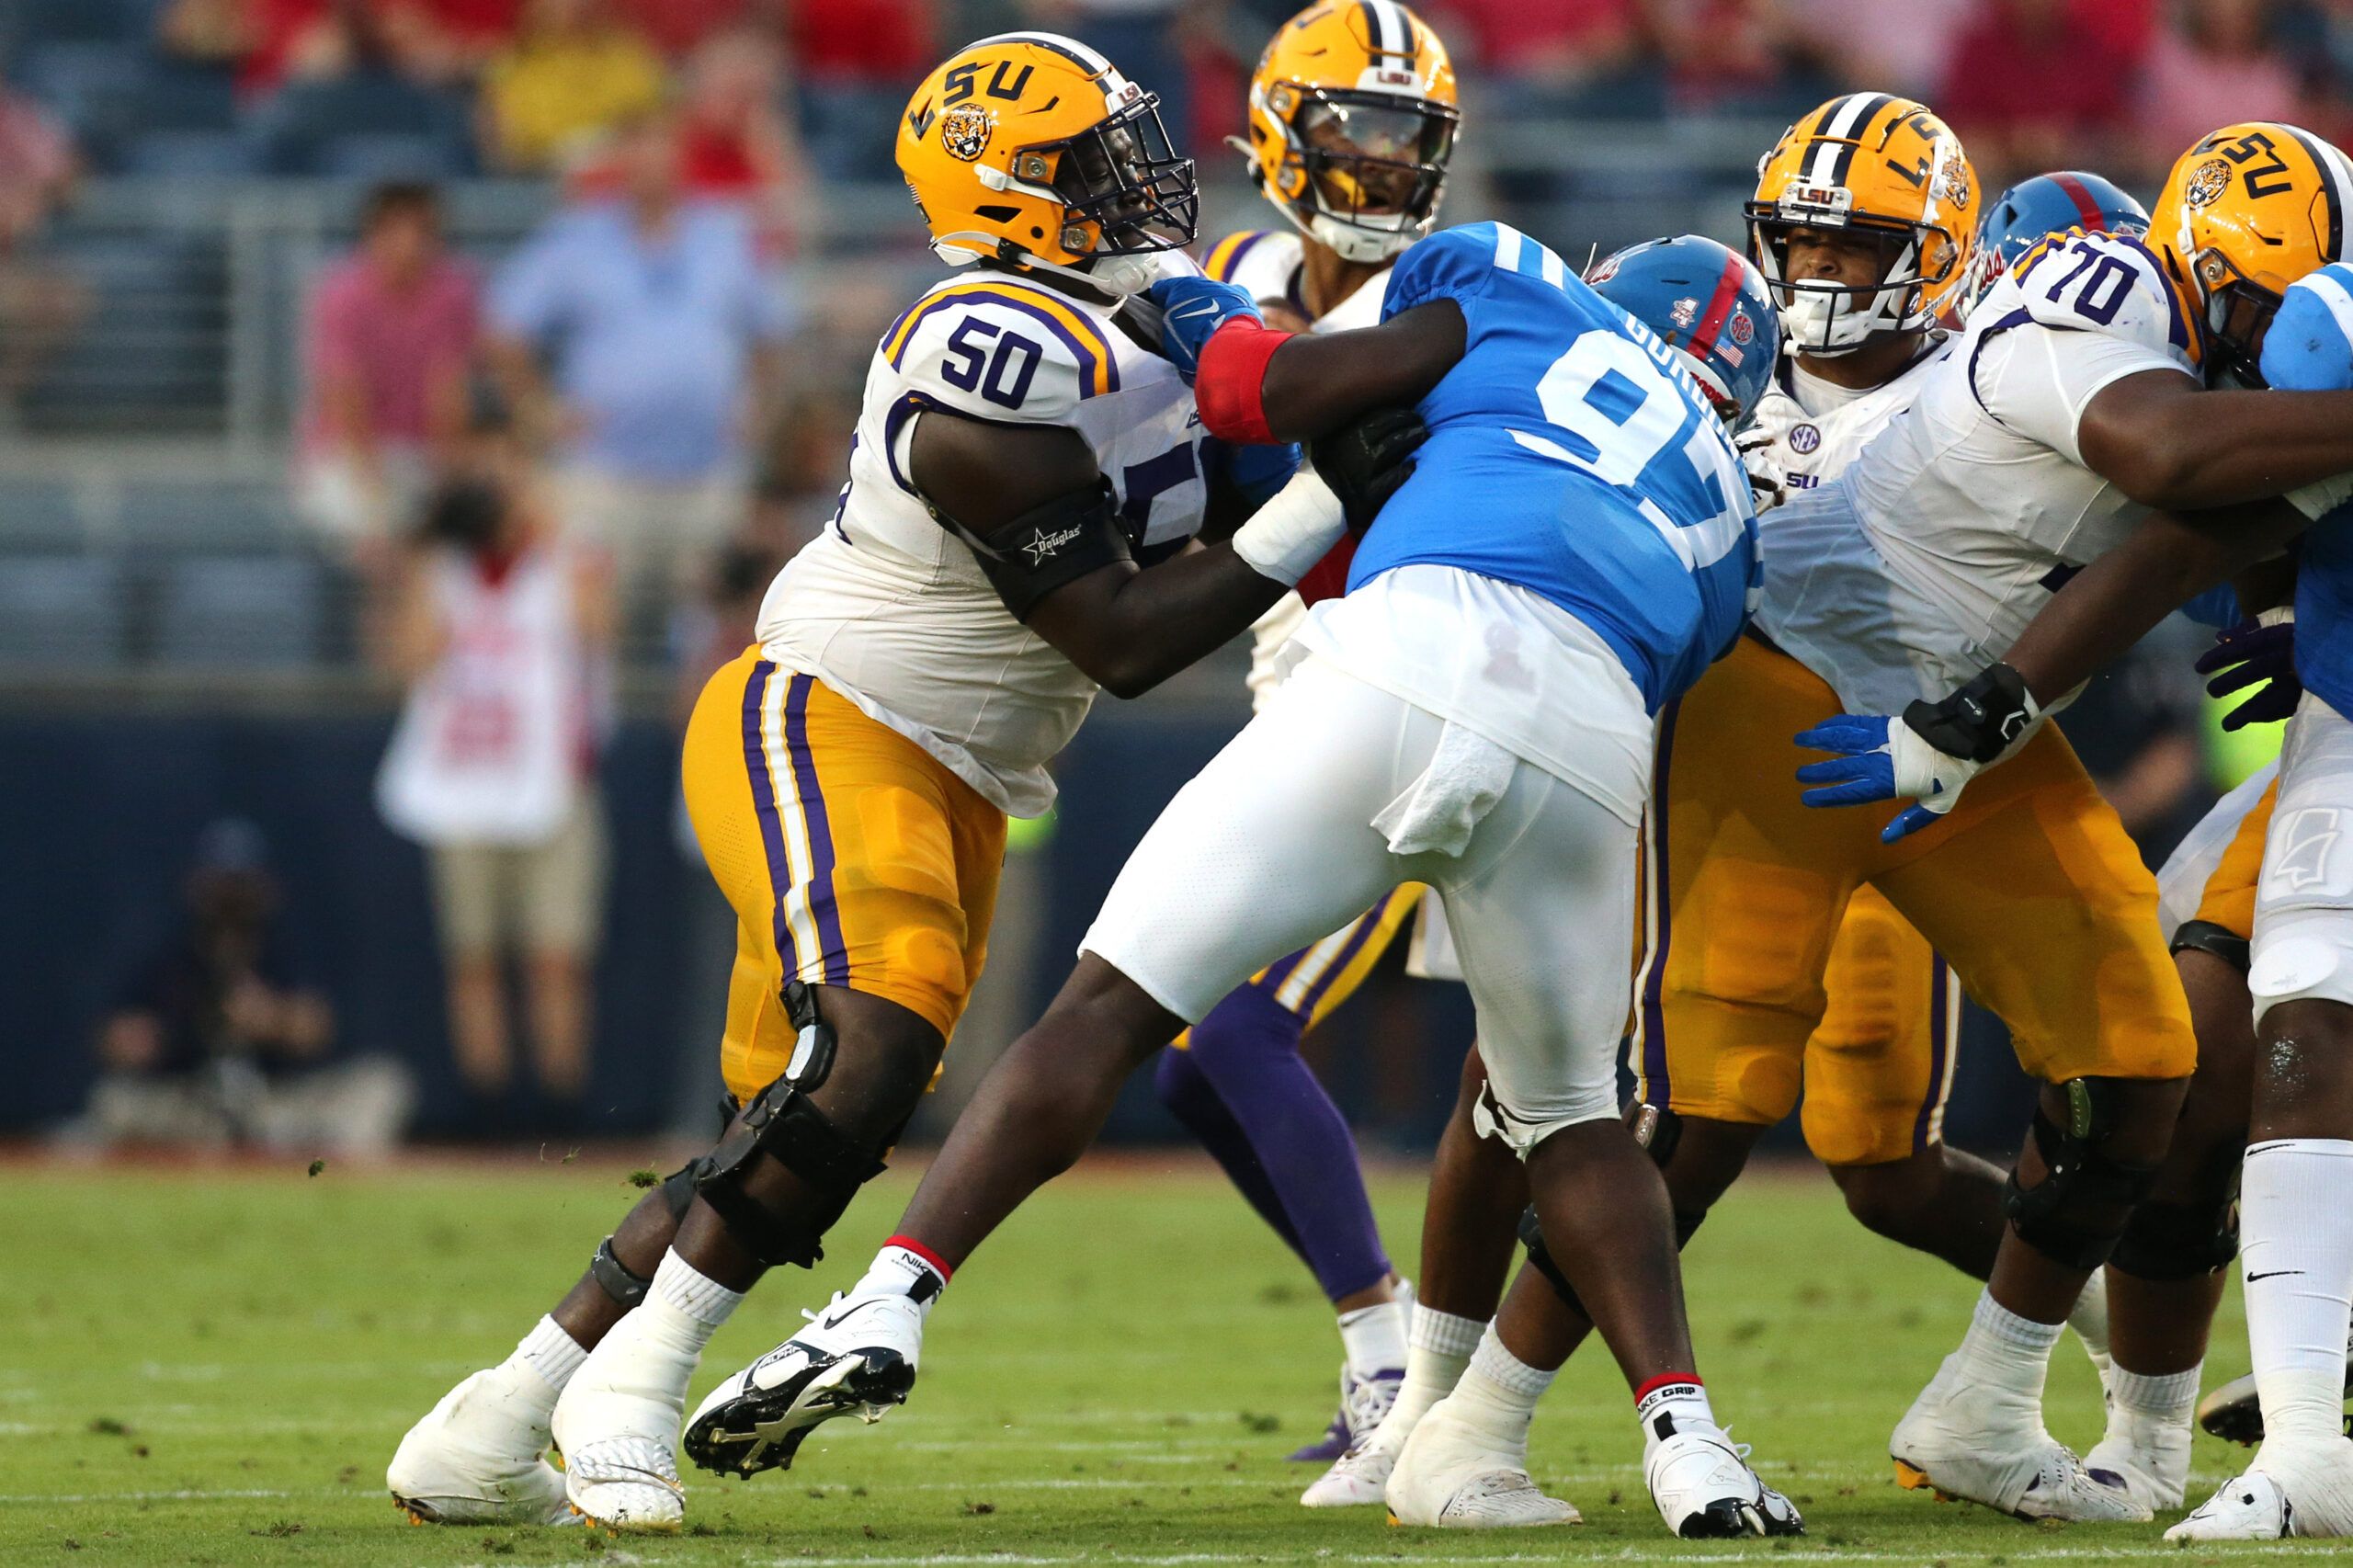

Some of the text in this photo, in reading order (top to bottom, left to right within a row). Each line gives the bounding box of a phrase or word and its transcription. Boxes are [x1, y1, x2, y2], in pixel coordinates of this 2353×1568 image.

[908, 61, 1034, 142] LSU
[1798, 187, 1834, 205] LSU
[2045, 241, 2140, 326] 70
[941, 315, 1042, 410] 50
[1790, 425, 1820, 453] SEC
[1787, 472, 1819, 489] SU
[1038, 528, 1080, 552] Douglas
[902, 1253, 929, 1273] NIK
[1662, 1386, 1696, 1397] GRIP
